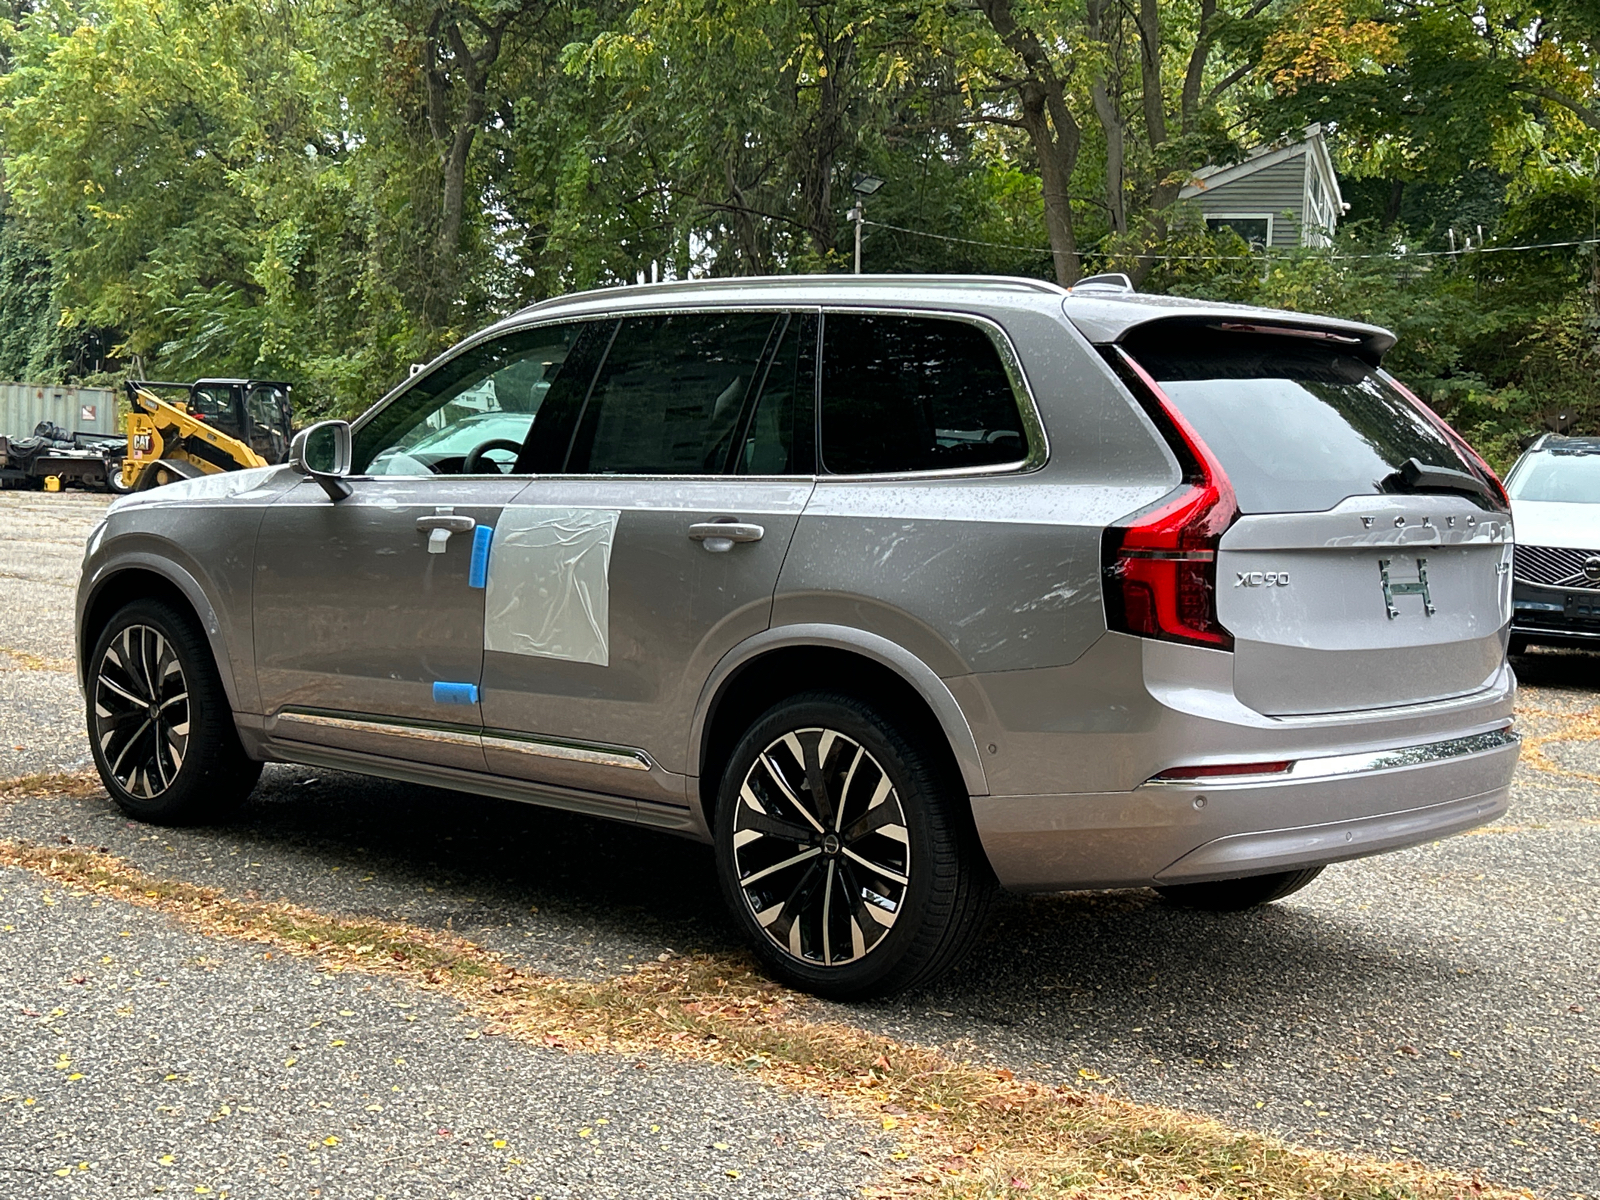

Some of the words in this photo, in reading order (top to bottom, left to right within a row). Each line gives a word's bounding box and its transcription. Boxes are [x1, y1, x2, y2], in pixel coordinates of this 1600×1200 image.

[133, 435, 150, 450] CAT
[1360, 515, 1475, 529] VOLVO
[1234, 571, 1290, 588] XC90
